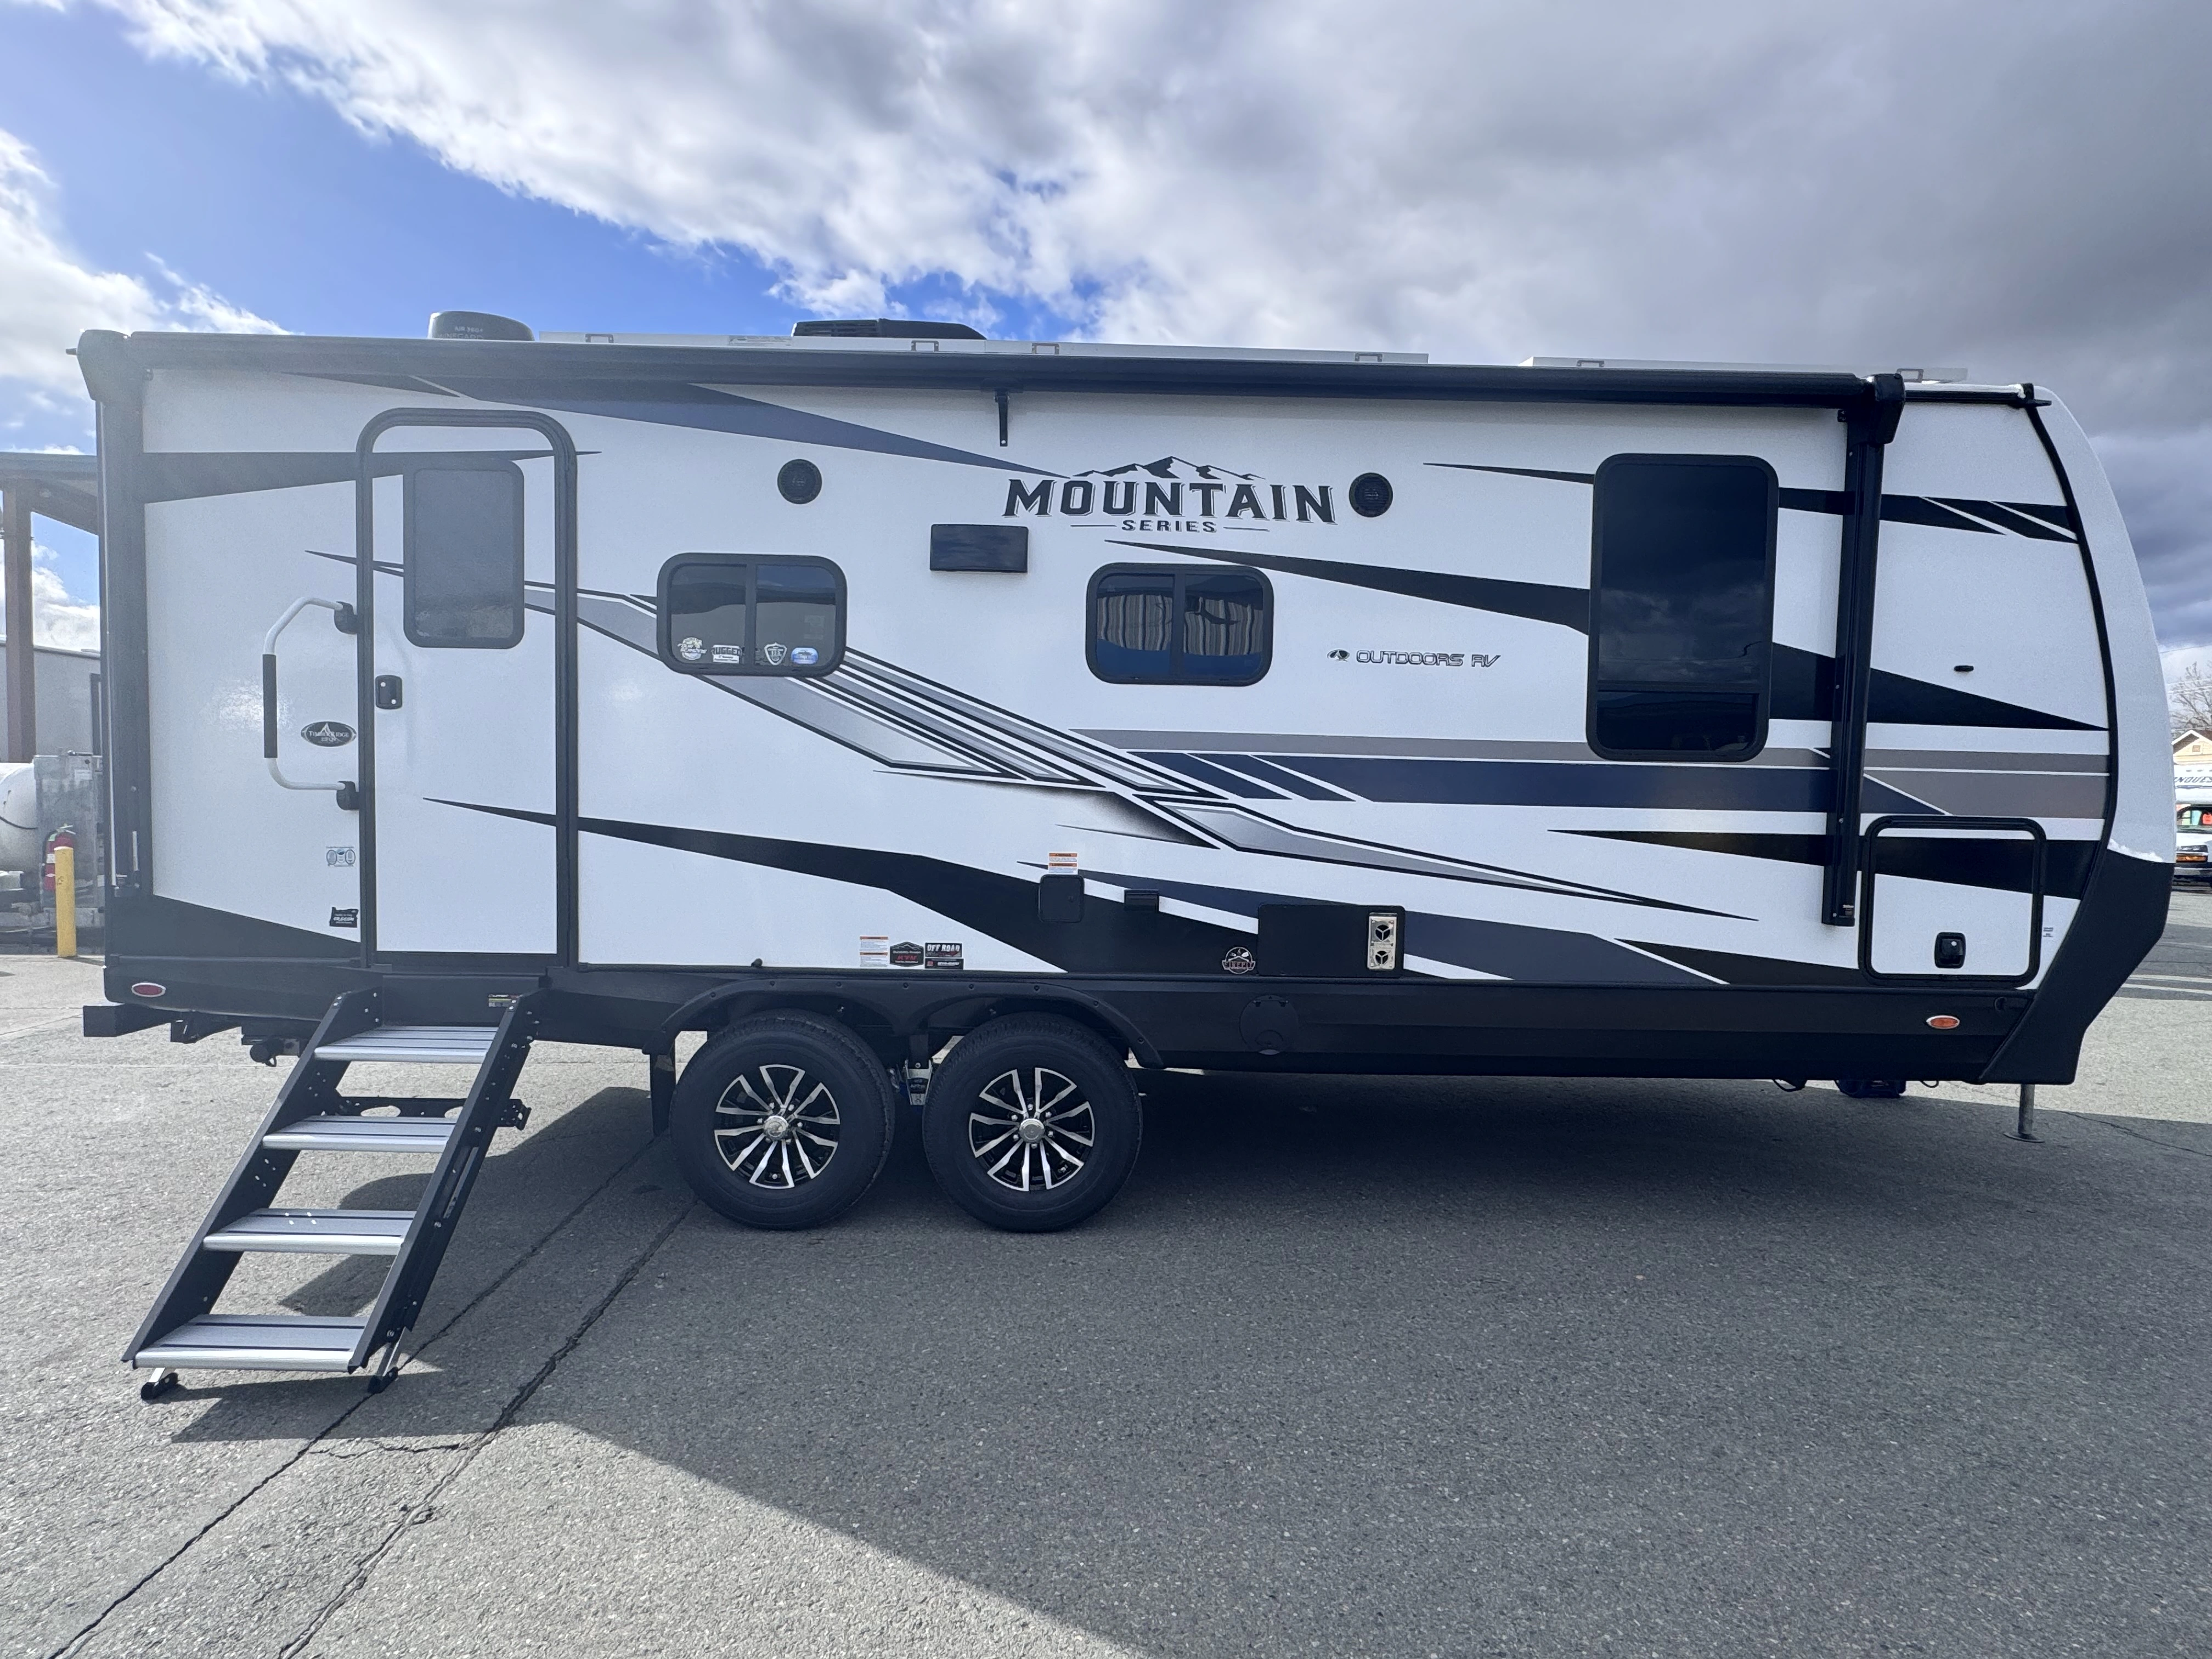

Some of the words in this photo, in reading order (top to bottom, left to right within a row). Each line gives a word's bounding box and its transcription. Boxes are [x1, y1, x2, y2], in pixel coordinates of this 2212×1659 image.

[1002, 478, 1338, 524] MOUNTAIN
[1121, 520, 1217, 533] SERIES
[1356, 650, 1465, 667] OUTDOORS
[1471, 654, 1501, 668] RV
[927, 944, 940, 952] OFF
[941, 944, 960, 952] ROAD
